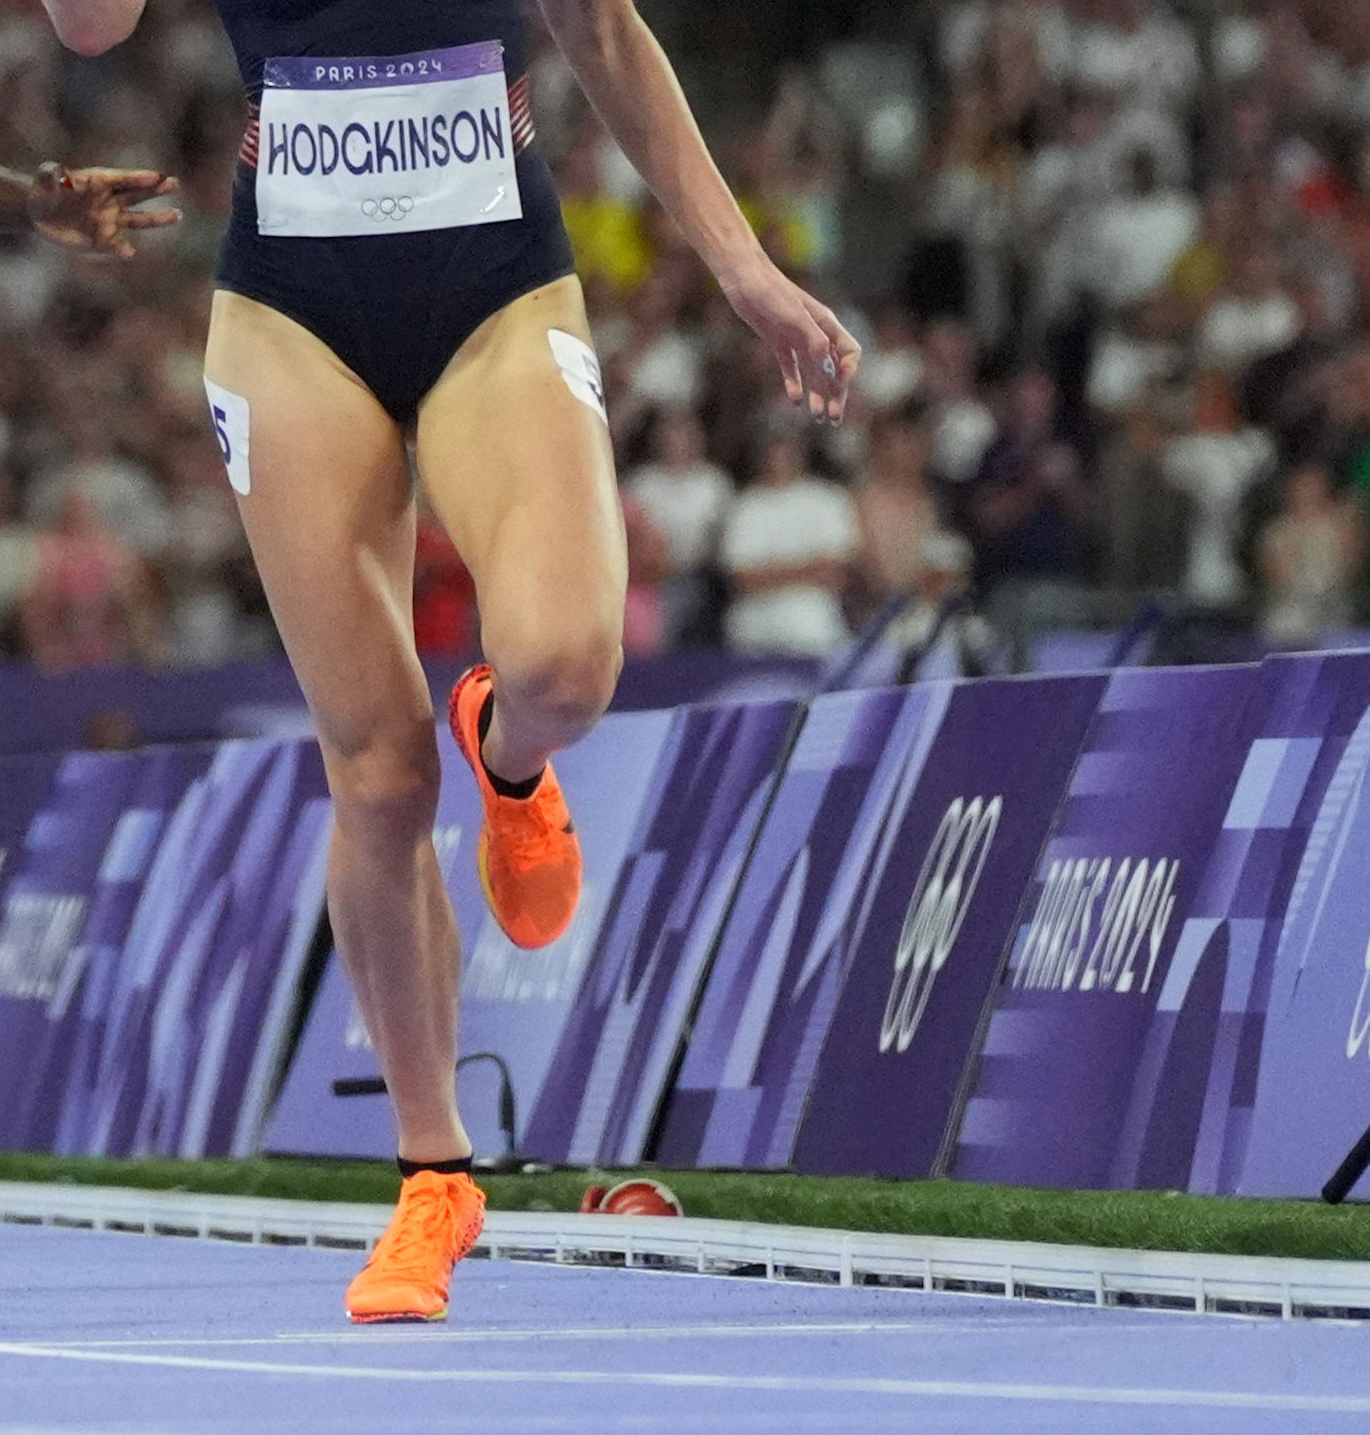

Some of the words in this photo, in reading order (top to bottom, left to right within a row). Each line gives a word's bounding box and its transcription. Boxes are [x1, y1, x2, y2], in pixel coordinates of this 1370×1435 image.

[316, 65, 378, 82] PARIS
[386, 60, 442, 78] 2024
[268, 107, 505, 176] HODGKINSON
